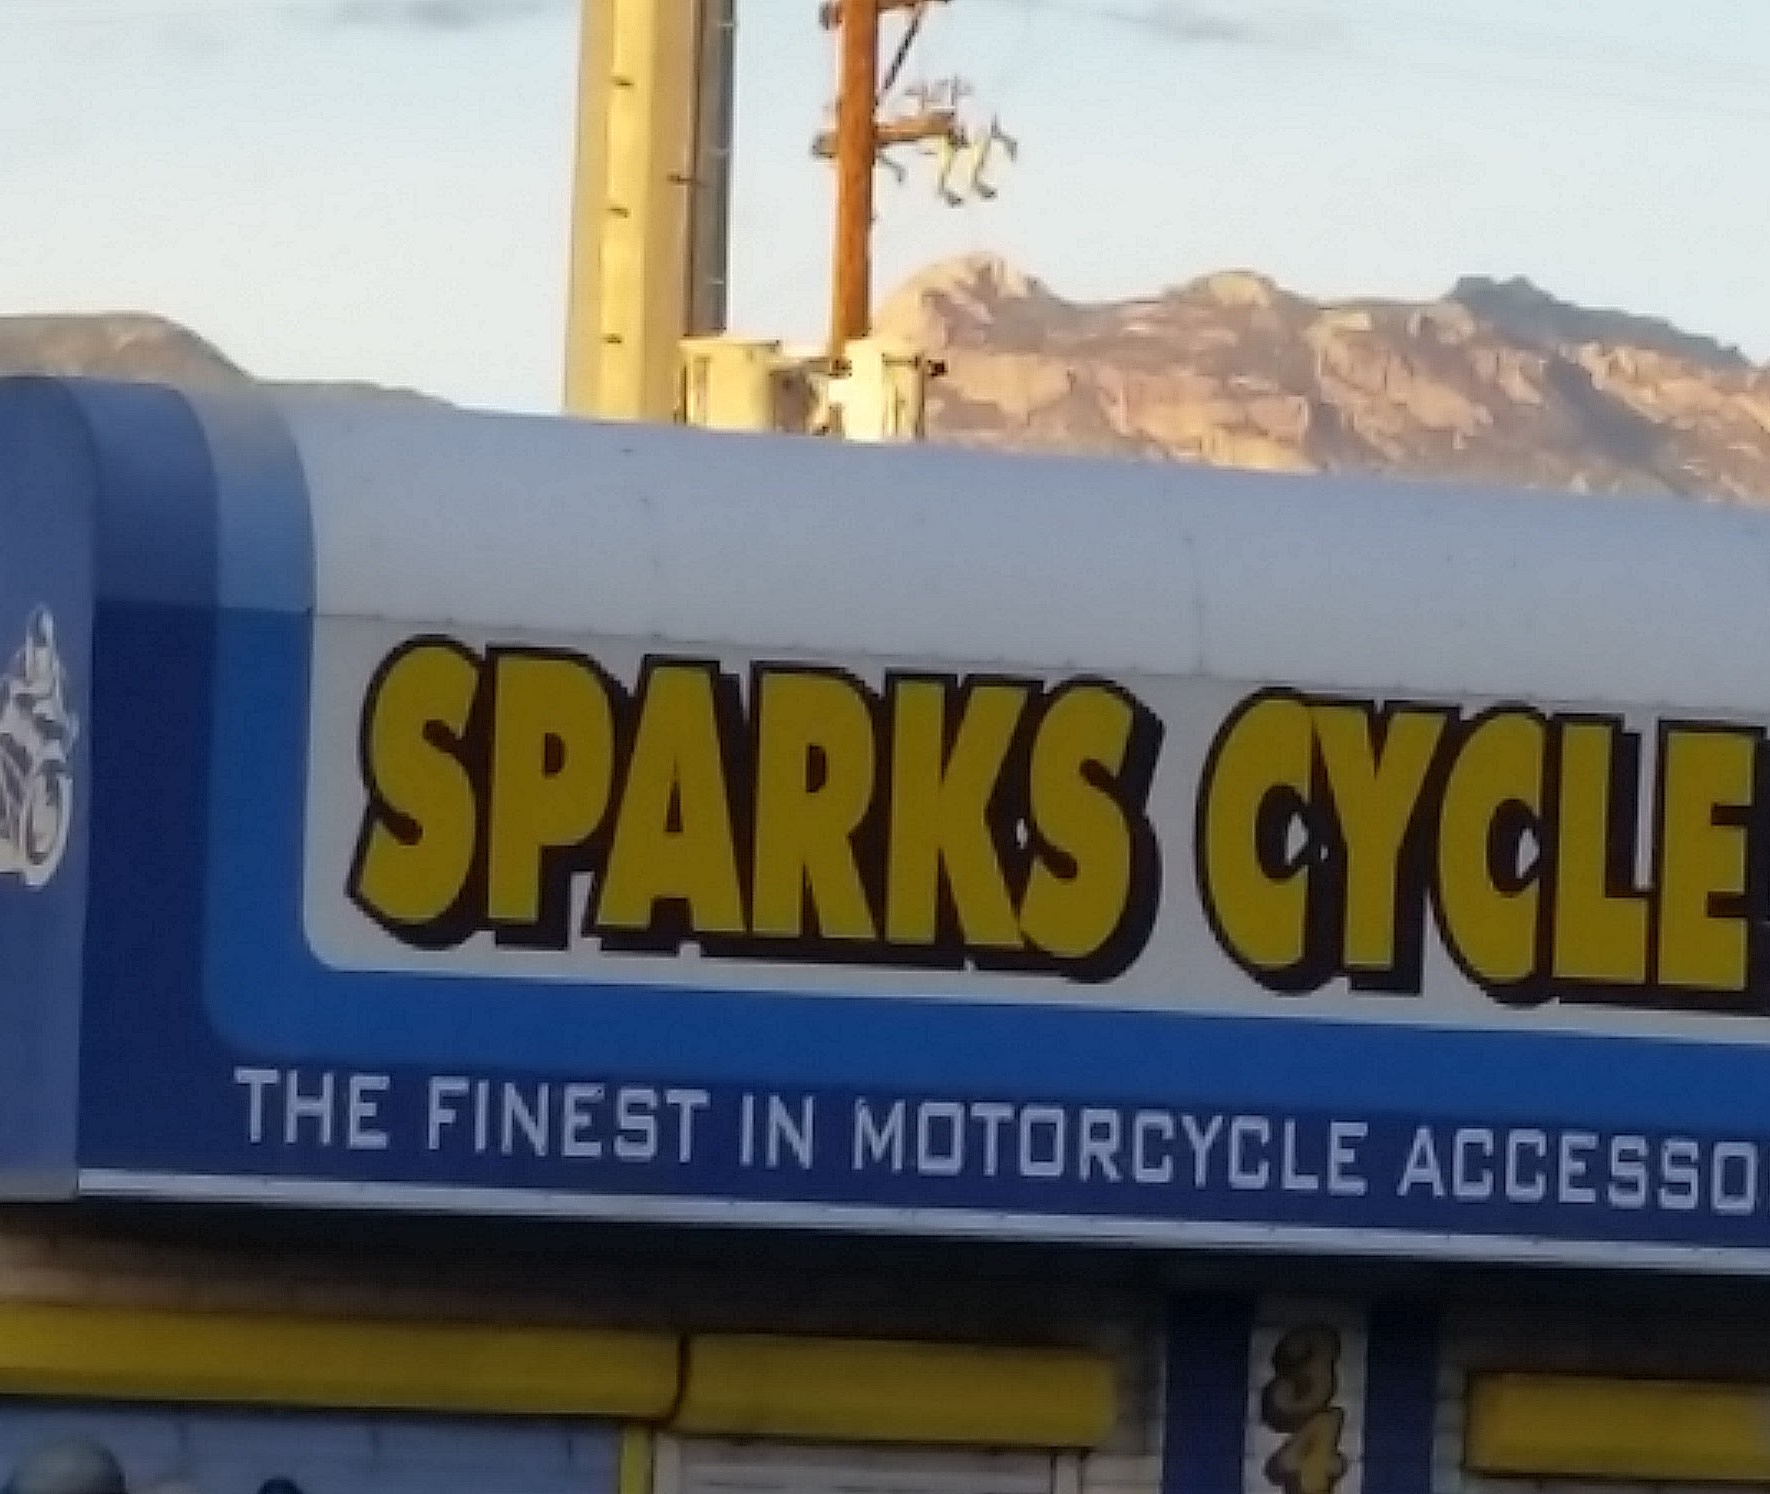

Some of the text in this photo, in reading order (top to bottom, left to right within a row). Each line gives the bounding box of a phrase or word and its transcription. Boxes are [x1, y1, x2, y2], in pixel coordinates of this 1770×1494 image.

[347, 634, 1163, 980] SPARKS
[233, 1067, 391, 1149] THE
[426, 1076, 710, 1161] FINEST
[739, 1094, 817, 1170] IN
[851, 1097, 1370, 1197] MOTORCYCLE
